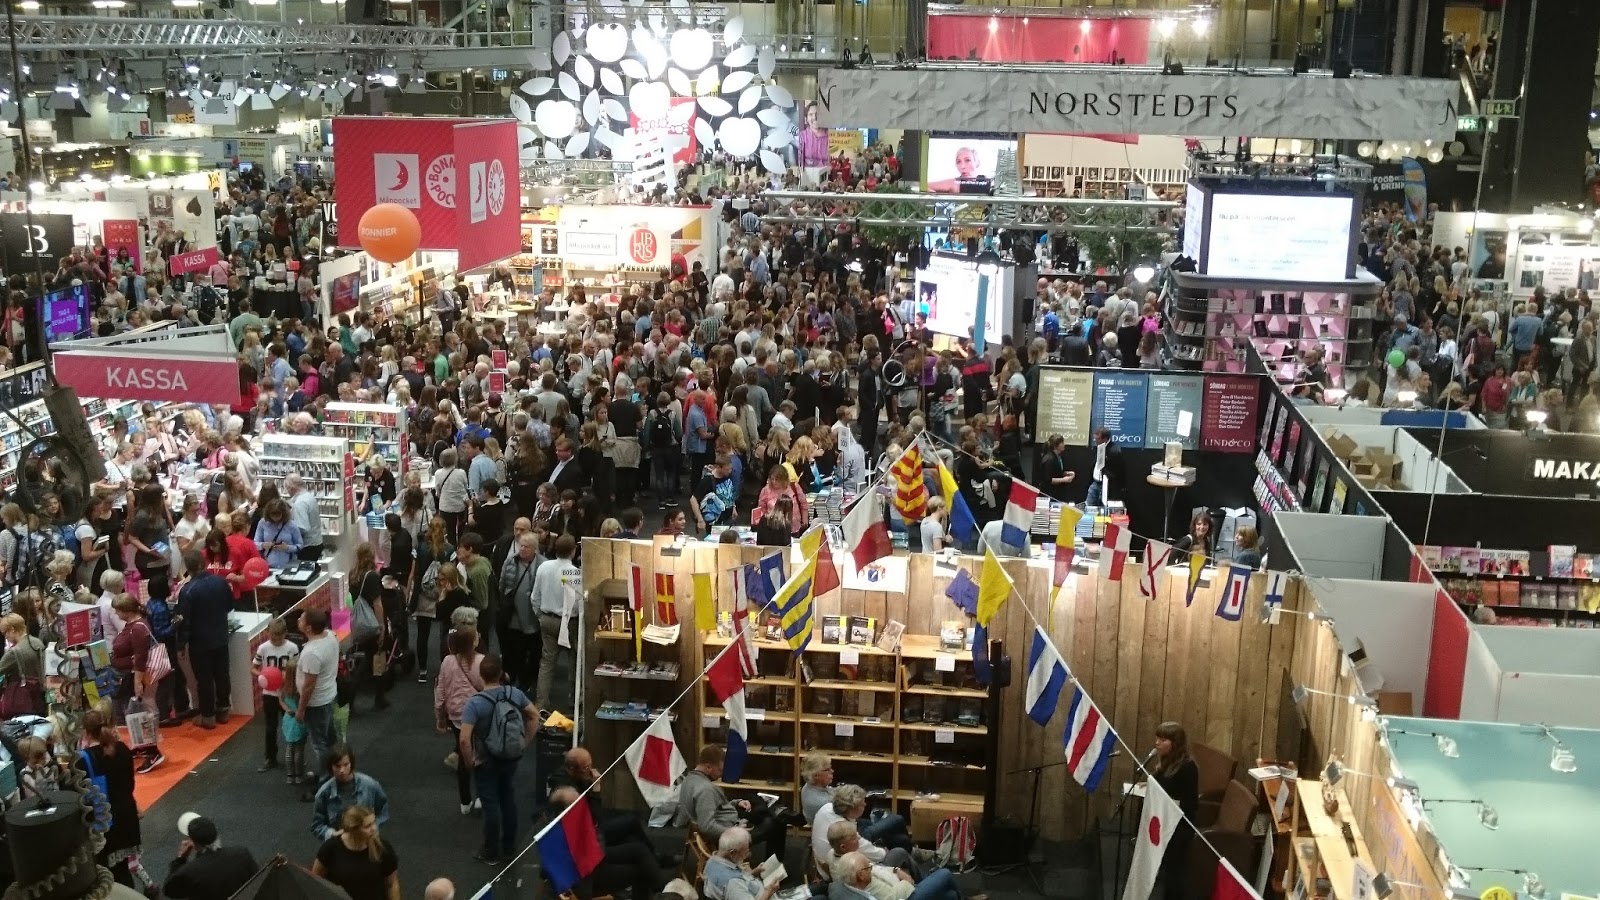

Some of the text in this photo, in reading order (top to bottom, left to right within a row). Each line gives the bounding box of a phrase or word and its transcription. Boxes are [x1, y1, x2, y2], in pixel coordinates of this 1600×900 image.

[1029, 91, 1238, 119] NORSTEDTS
[1373, 175, 1394, 184] FOOD
[22, 224, 49, 253] B
[360, 227, 398, 238] BONNIER
[183, 254, 207, 268] KASSA
[106, 366, 188, 391] KASSA
[1098, 378, 1114, 386] FREDAG
[1112, 433, 1141, 442] D&CO
[1204, 438, 1251, 447] LIND&CO
[1533, 458, 1600, 480] MAKA
